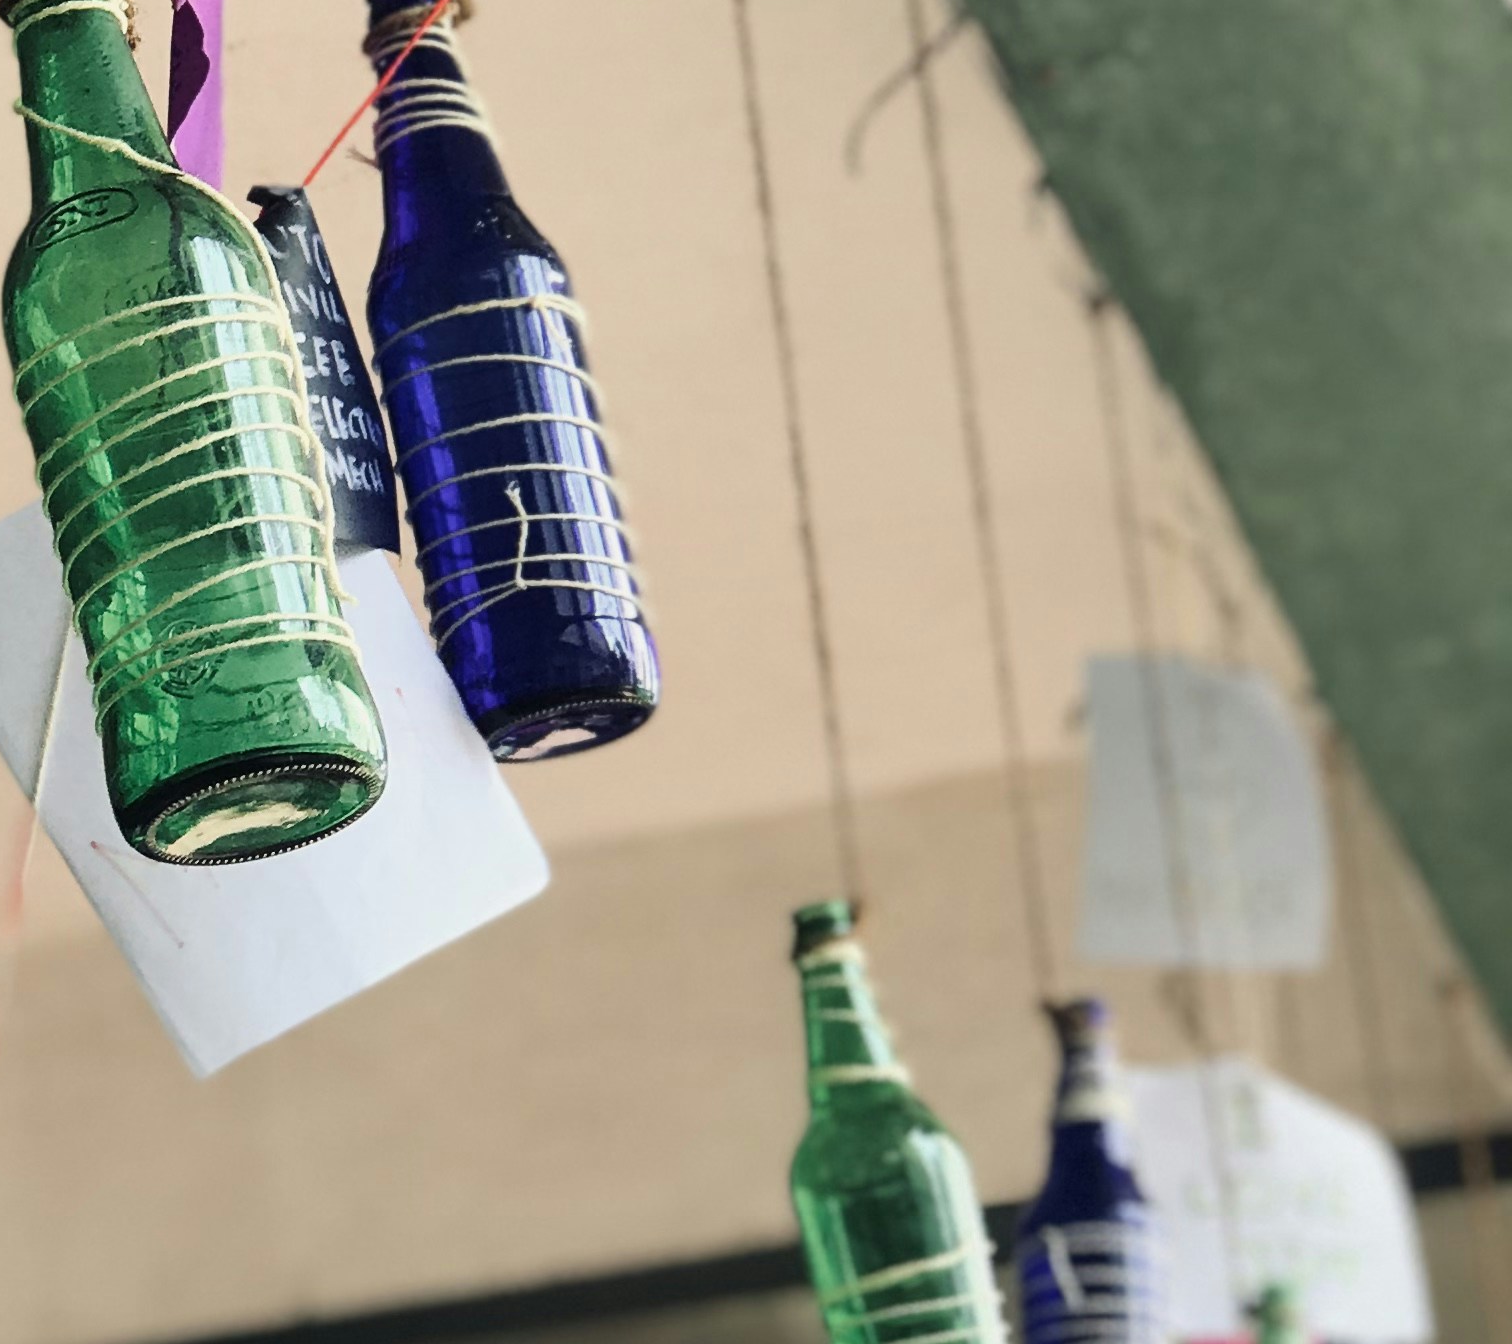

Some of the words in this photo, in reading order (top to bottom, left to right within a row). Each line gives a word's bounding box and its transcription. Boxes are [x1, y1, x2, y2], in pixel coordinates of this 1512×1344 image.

[261, 223, 332, 286] UTO
[282, 279, 348, 326] IVIL
[324, 446, 386, 493] MECH
